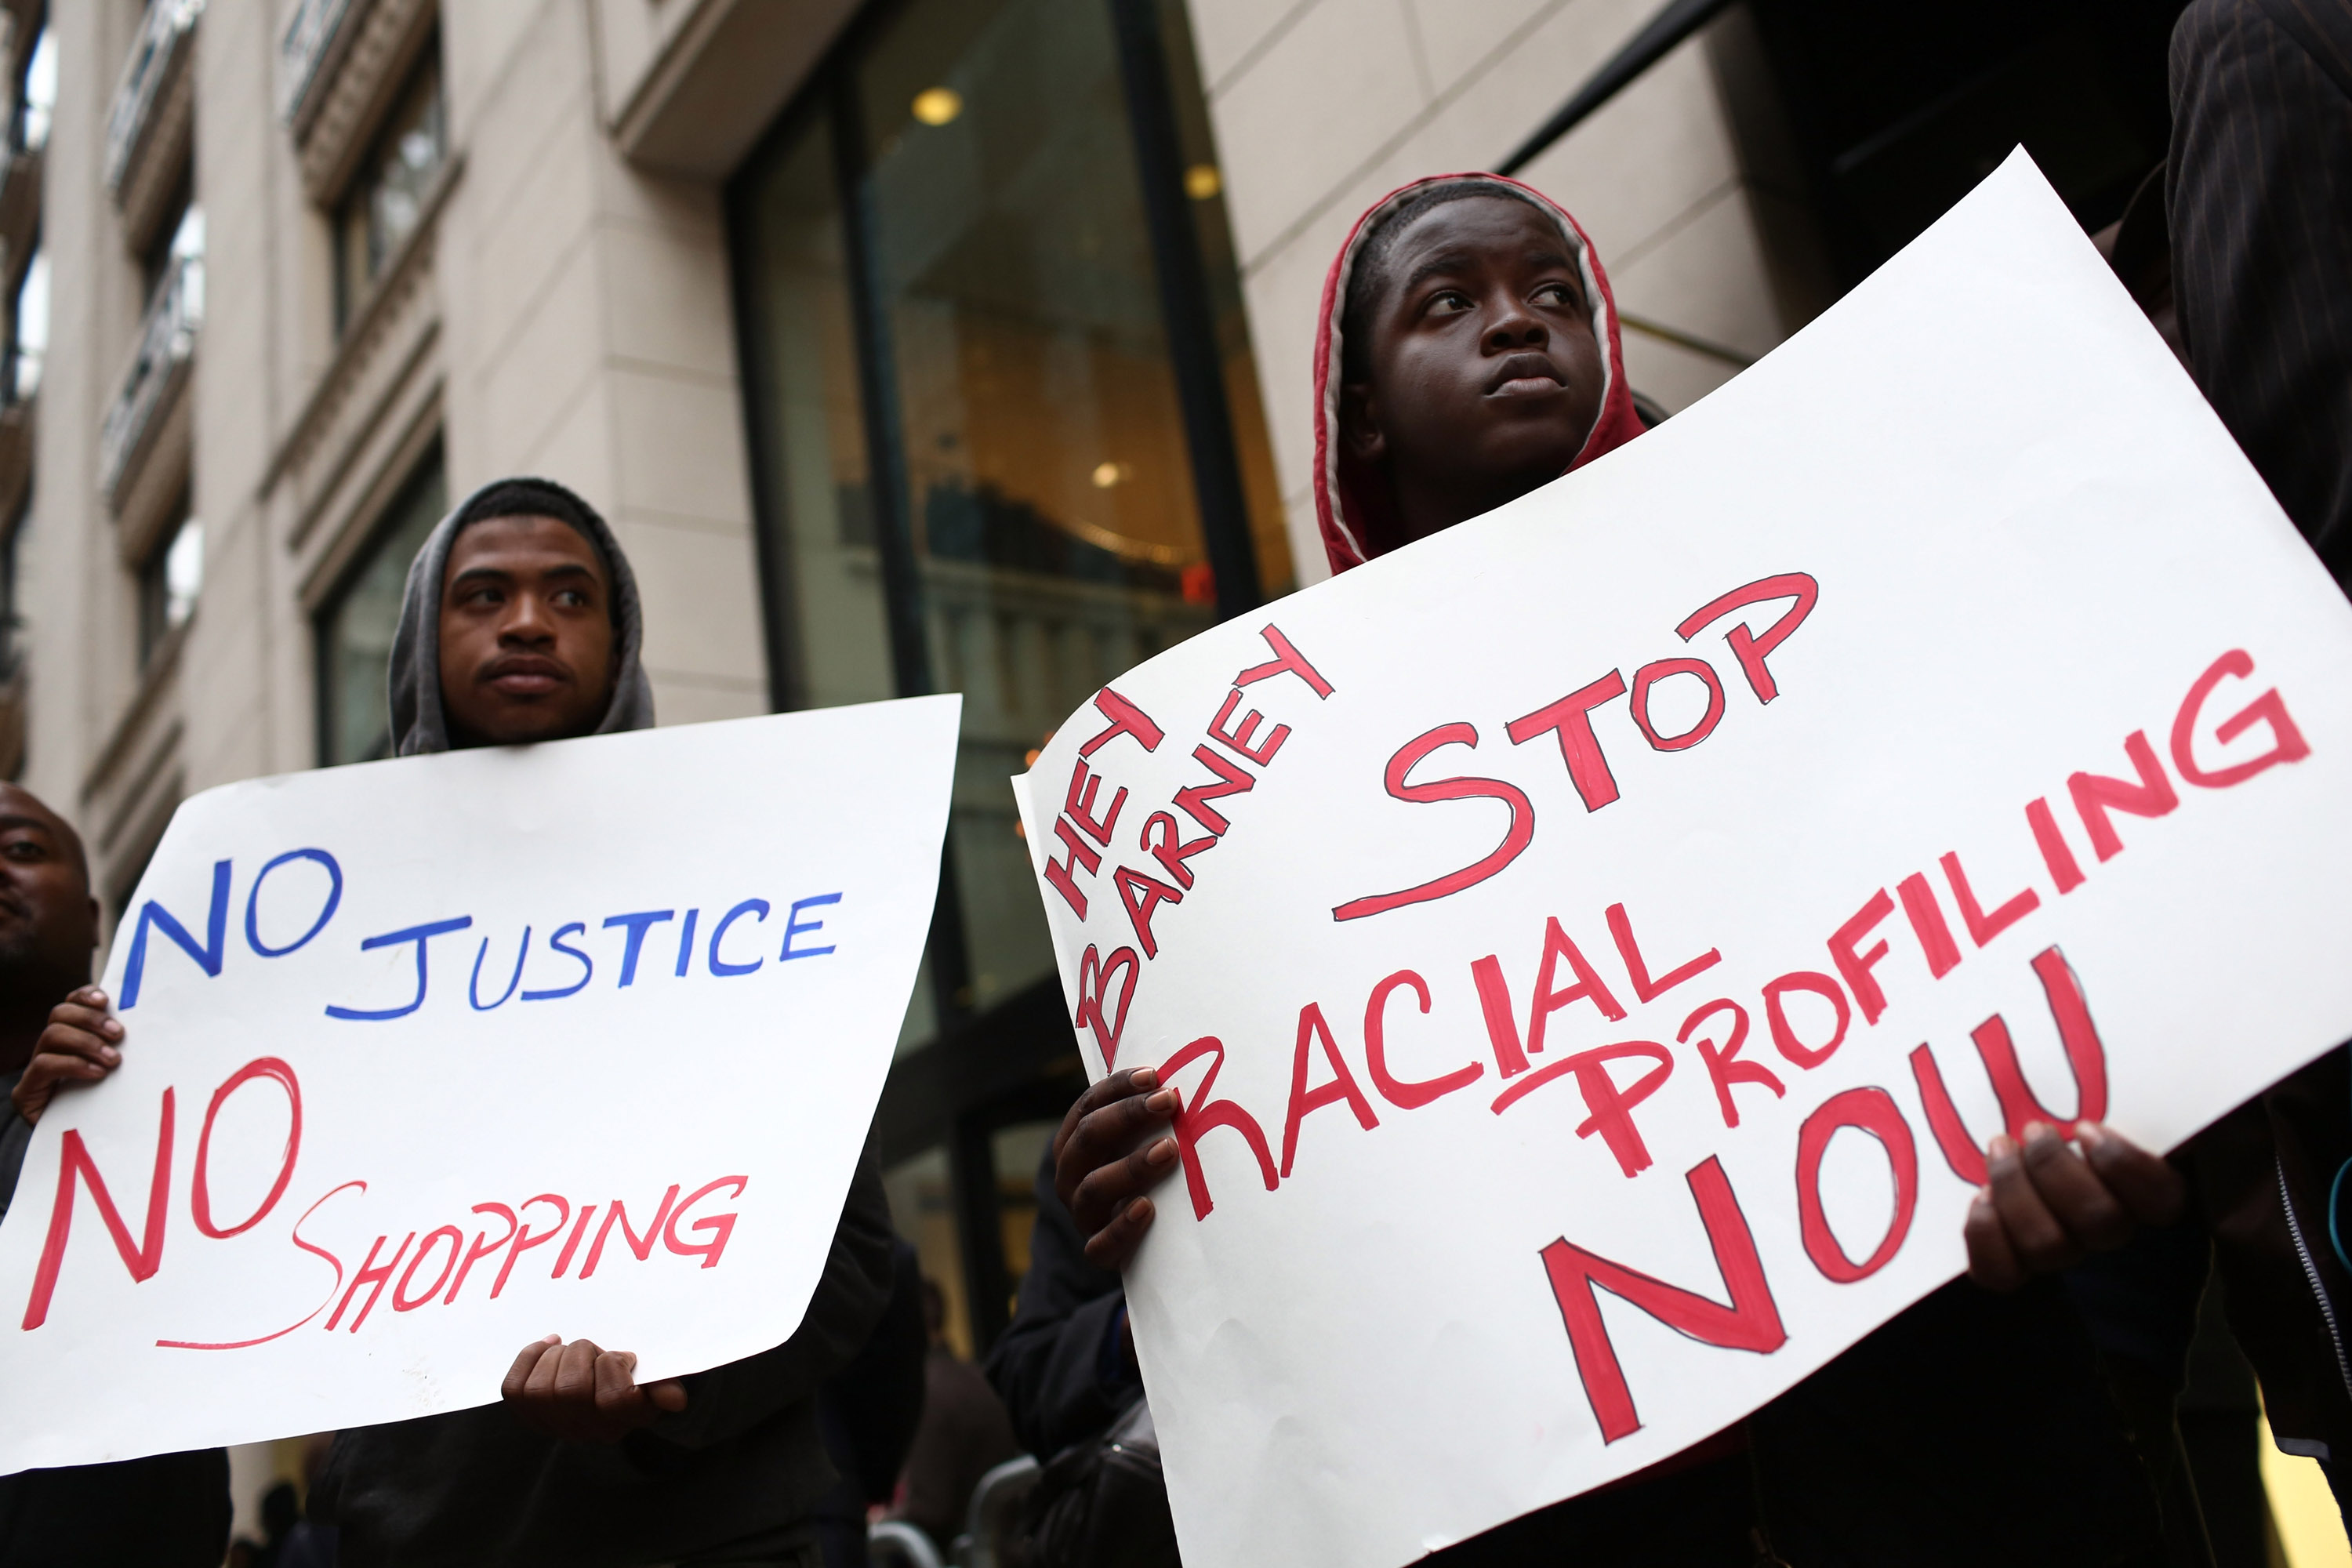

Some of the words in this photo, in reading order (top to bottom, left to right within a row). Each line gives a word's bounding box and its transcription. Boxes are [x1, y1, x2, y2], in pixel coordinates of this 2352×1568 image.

[1044, 687, 1165, 922] HEY
[1076, 622, 1335, 1076] BARNEY
[1332, 572, 1819, 922] STOP
[117, 847, 344, 1013] NO
[323, 891, 844, 1023] JUSTICE
[1150, 902, 1722, 1221] RACIAL
[1490, 648, 2313, 1179] PROFILING
[20, 1055, 303, 1332] NO
[155, 1174, 750, 1352] SHOPPING
[1538, 945, 2111, 1444] NOW
